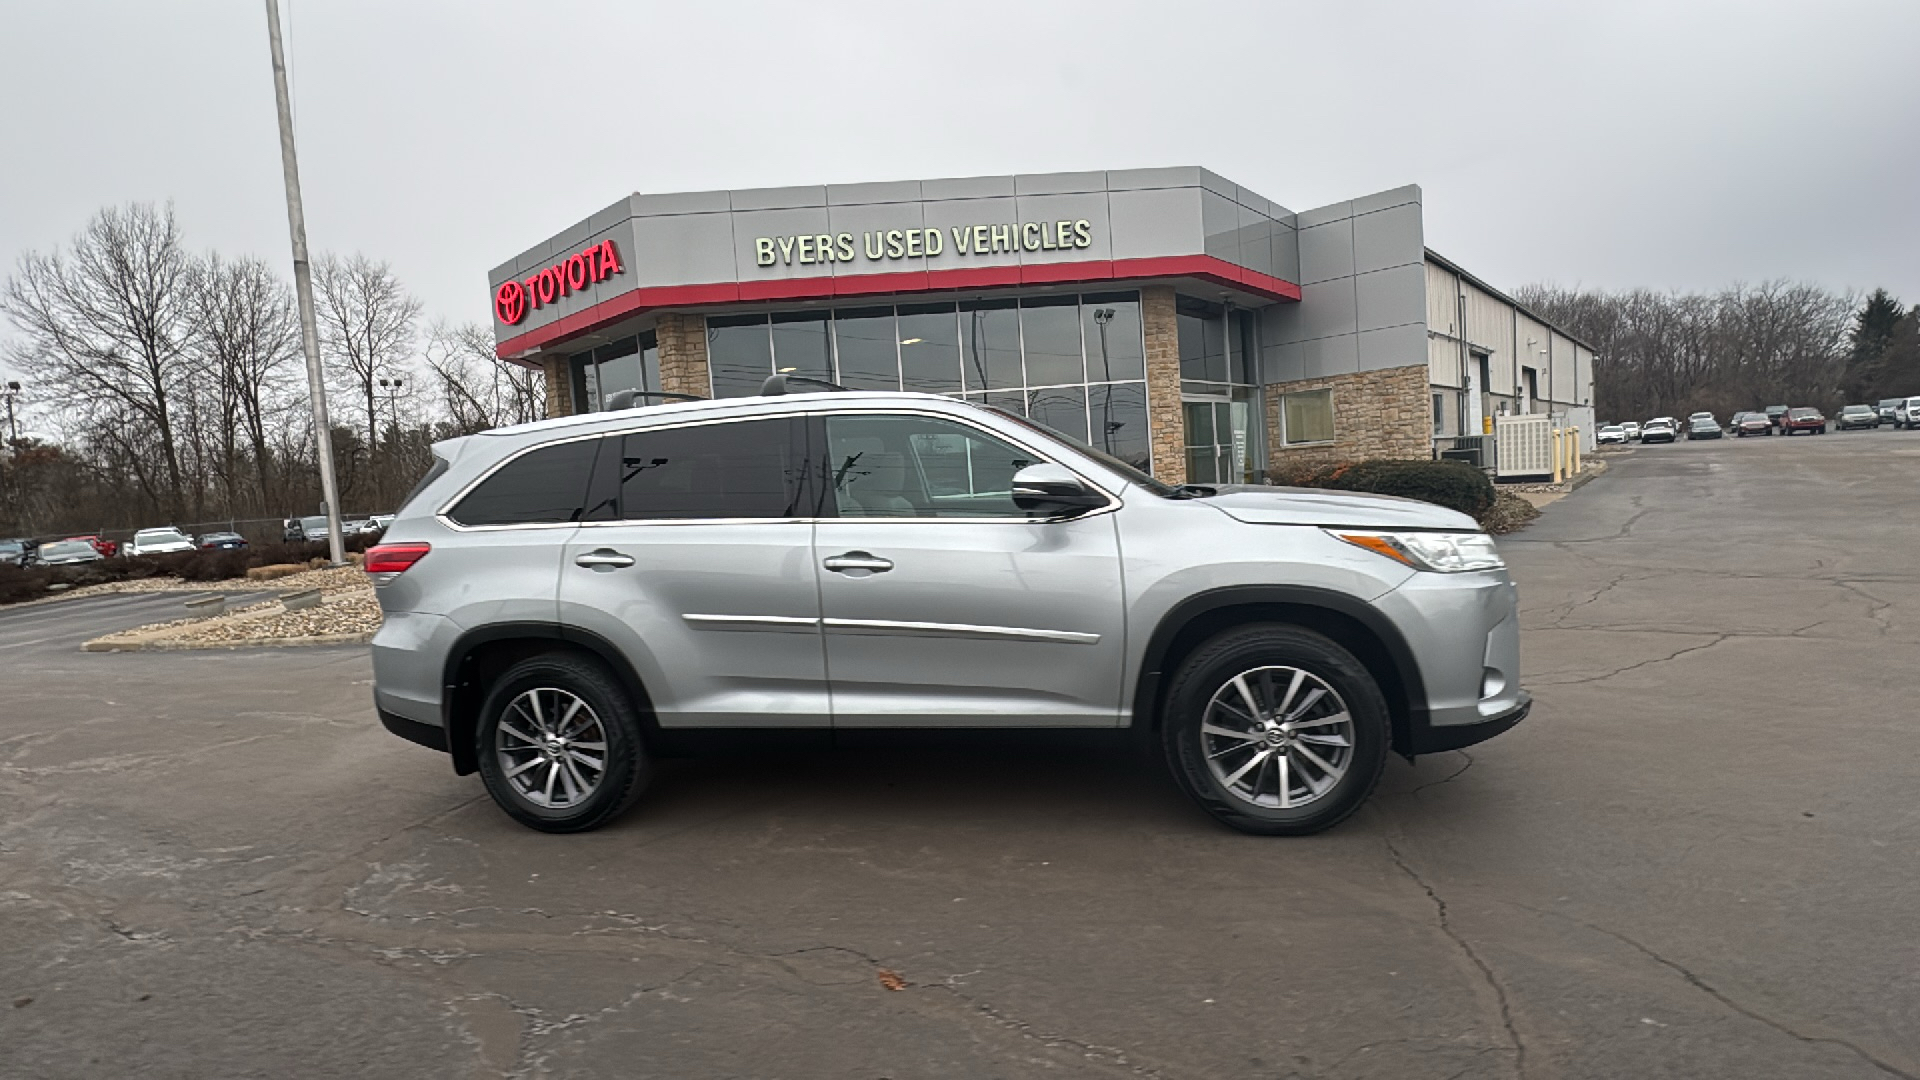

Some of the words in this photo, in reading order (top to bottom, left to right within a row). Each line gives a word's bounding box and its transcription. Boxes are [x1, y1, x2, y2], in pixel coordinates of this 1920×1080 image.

[755, 232, 855, 266] BYERS
[864, 228, 943, 260] USED
[951, 219, 1092, 254] VEHICLES
[525, 239, 619, 309] TOYOTA
